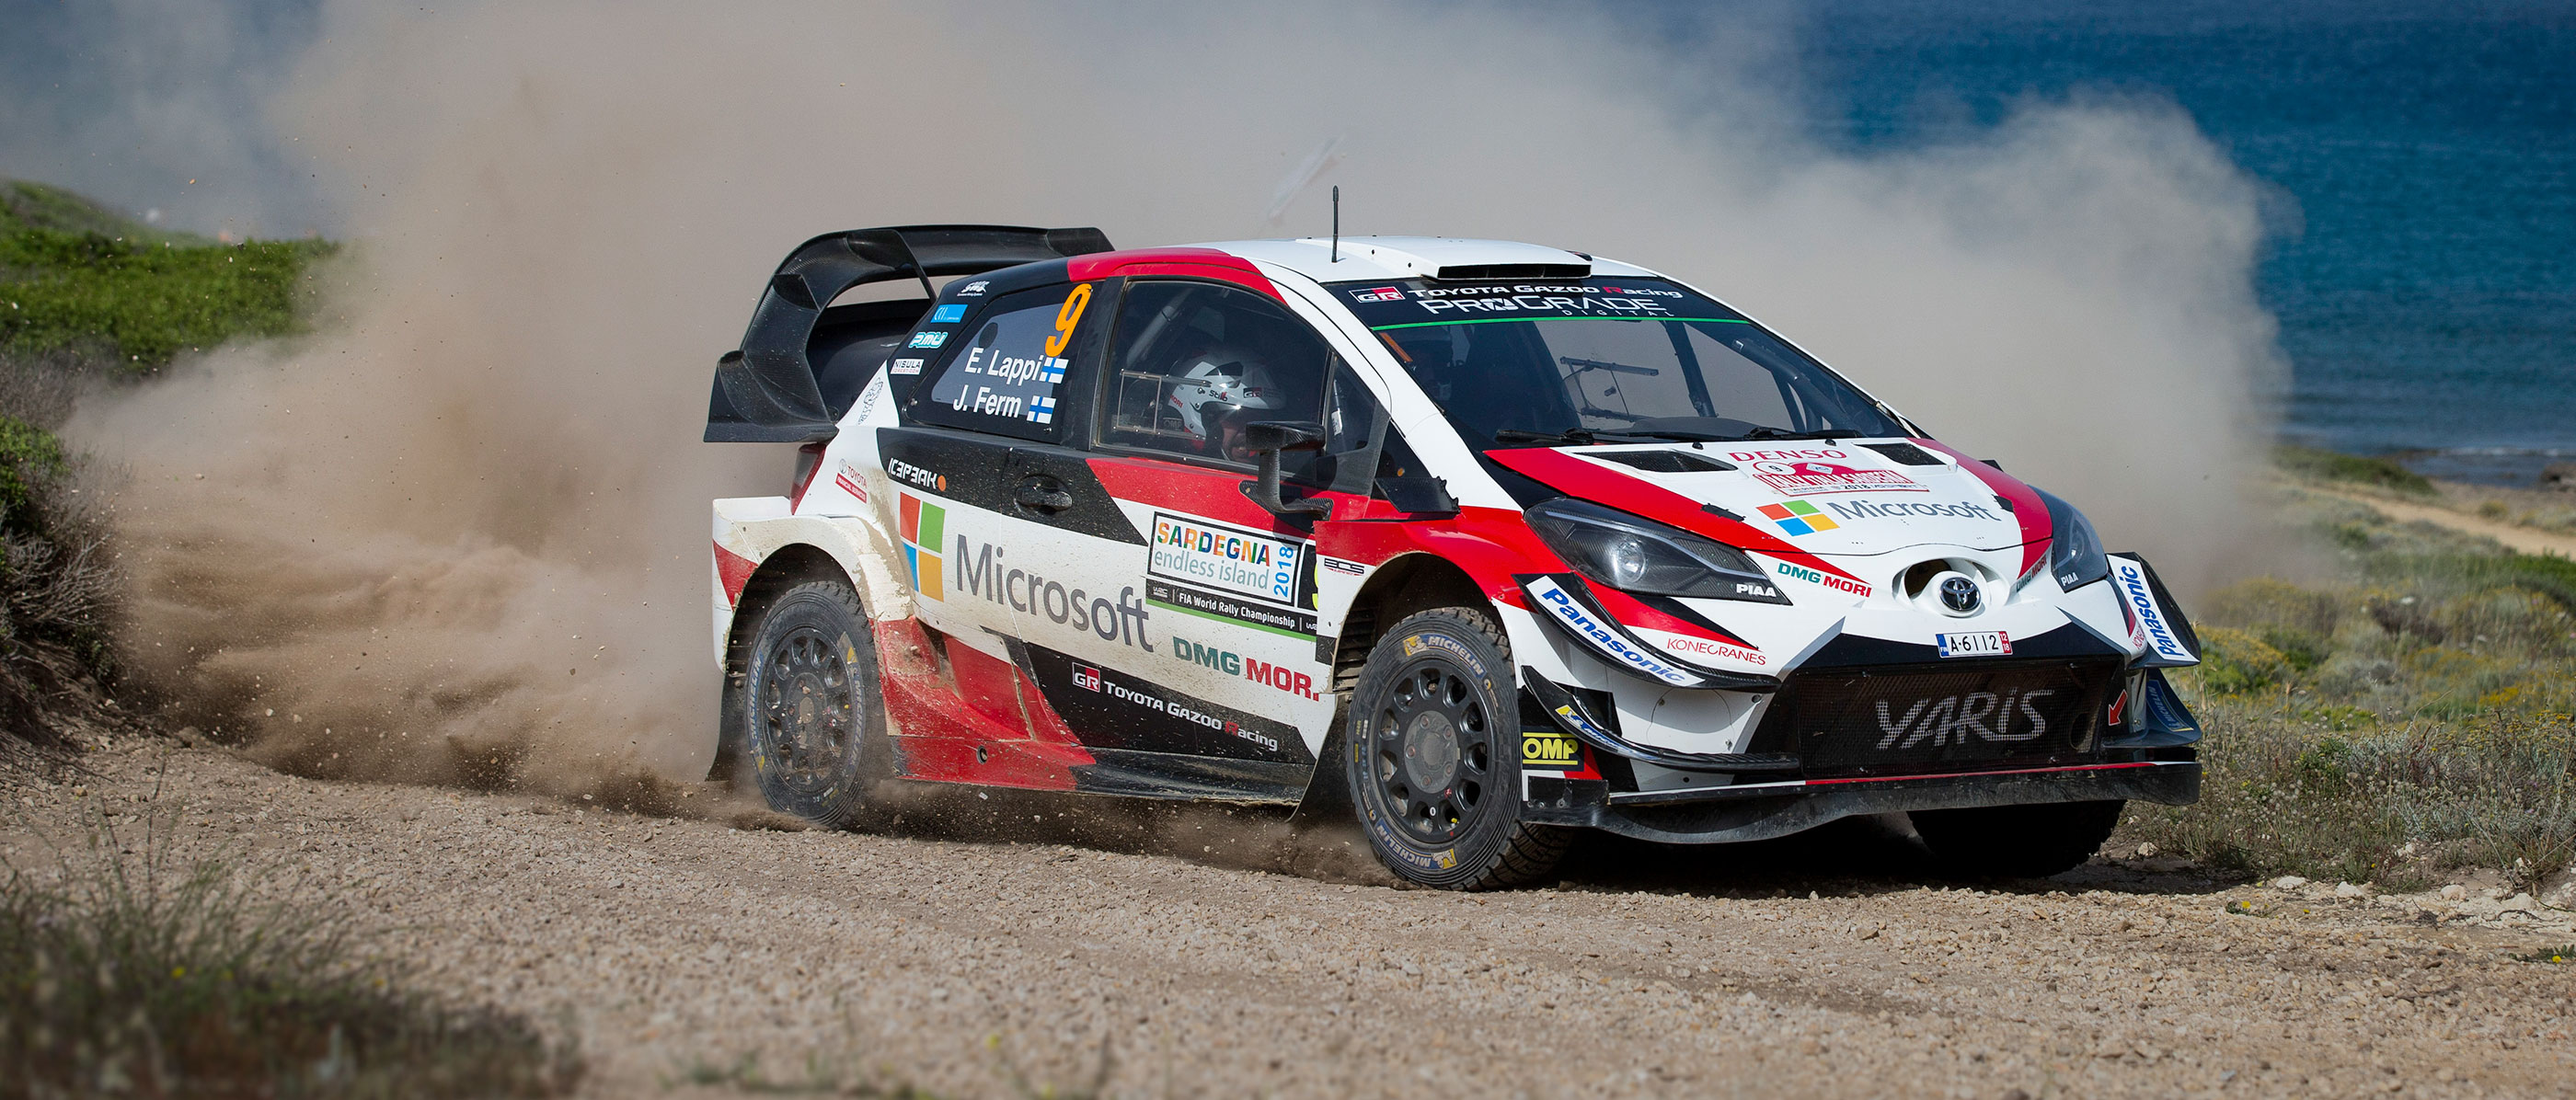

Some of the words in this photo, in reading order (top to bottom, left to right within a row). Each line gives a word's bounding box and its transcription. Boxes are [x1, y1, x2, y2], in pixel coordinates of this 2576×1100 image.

[1408, 286, 1511, 298] TOYOTA
[1512, 285, 1600, 293] GAZOO
[1602, 286, 1684, 299] Racing
[1045, 283, 1093, 357] 9
[1561, 309, 1674, 317] DIGITAL
[894, 361, 921, 369] NISULA
[965, 347, 983, 375] E.
[987, 349, 1044, 386] Lappi
[952, 384, 969, 412] J.
[972, 386, 1022, 418] Ferm
[1728, 449, 1848, 462] DENSO
[847, 465, 868, 489] TOYOTA
[1826, 499, 2003, 521] Microsoft
[1156, 521, 1271, 567] SARDEGNA
[1154, 548, 1215, 579] endless
[1218, 560, 1271, 590] island
[1273, 546, 1294, 598] 2018
[1777, 562, 1822, 584] DMG
[1823, 575, 1872, 598] MORI
[2061, 571, 2079, 587] PIAA
[956, 533, 1155, 653] Microsoft
[1736, 583, 1777, 598] PIAA
[1179, 592, 1192, 606] FIA
[1193, 595, 1217, 612] World
[1218, 600, 1239, 616] Rally
[1240, 606, 1296, 629] Championship
[2119, 565, 2186, 657] Panasonic
[1541, 587, 1686, 682] Panasonic
[1667, 637, 1766, 666] KONECRANES
[1999, 633, 2008, 641] 12
[1173, 636, 1240, 676] DMG
[1427, 636, 1484, 675] MICHELIN
[1104, 681, 1164, 712] TOYOTA
[1167, 702, 1222, 731] GAZOO
[1225, 720, 1278, 752] Racing
[1522, 737, 1579, 761] OMP
[1376, 825, 1432, 867] MICHELIN
